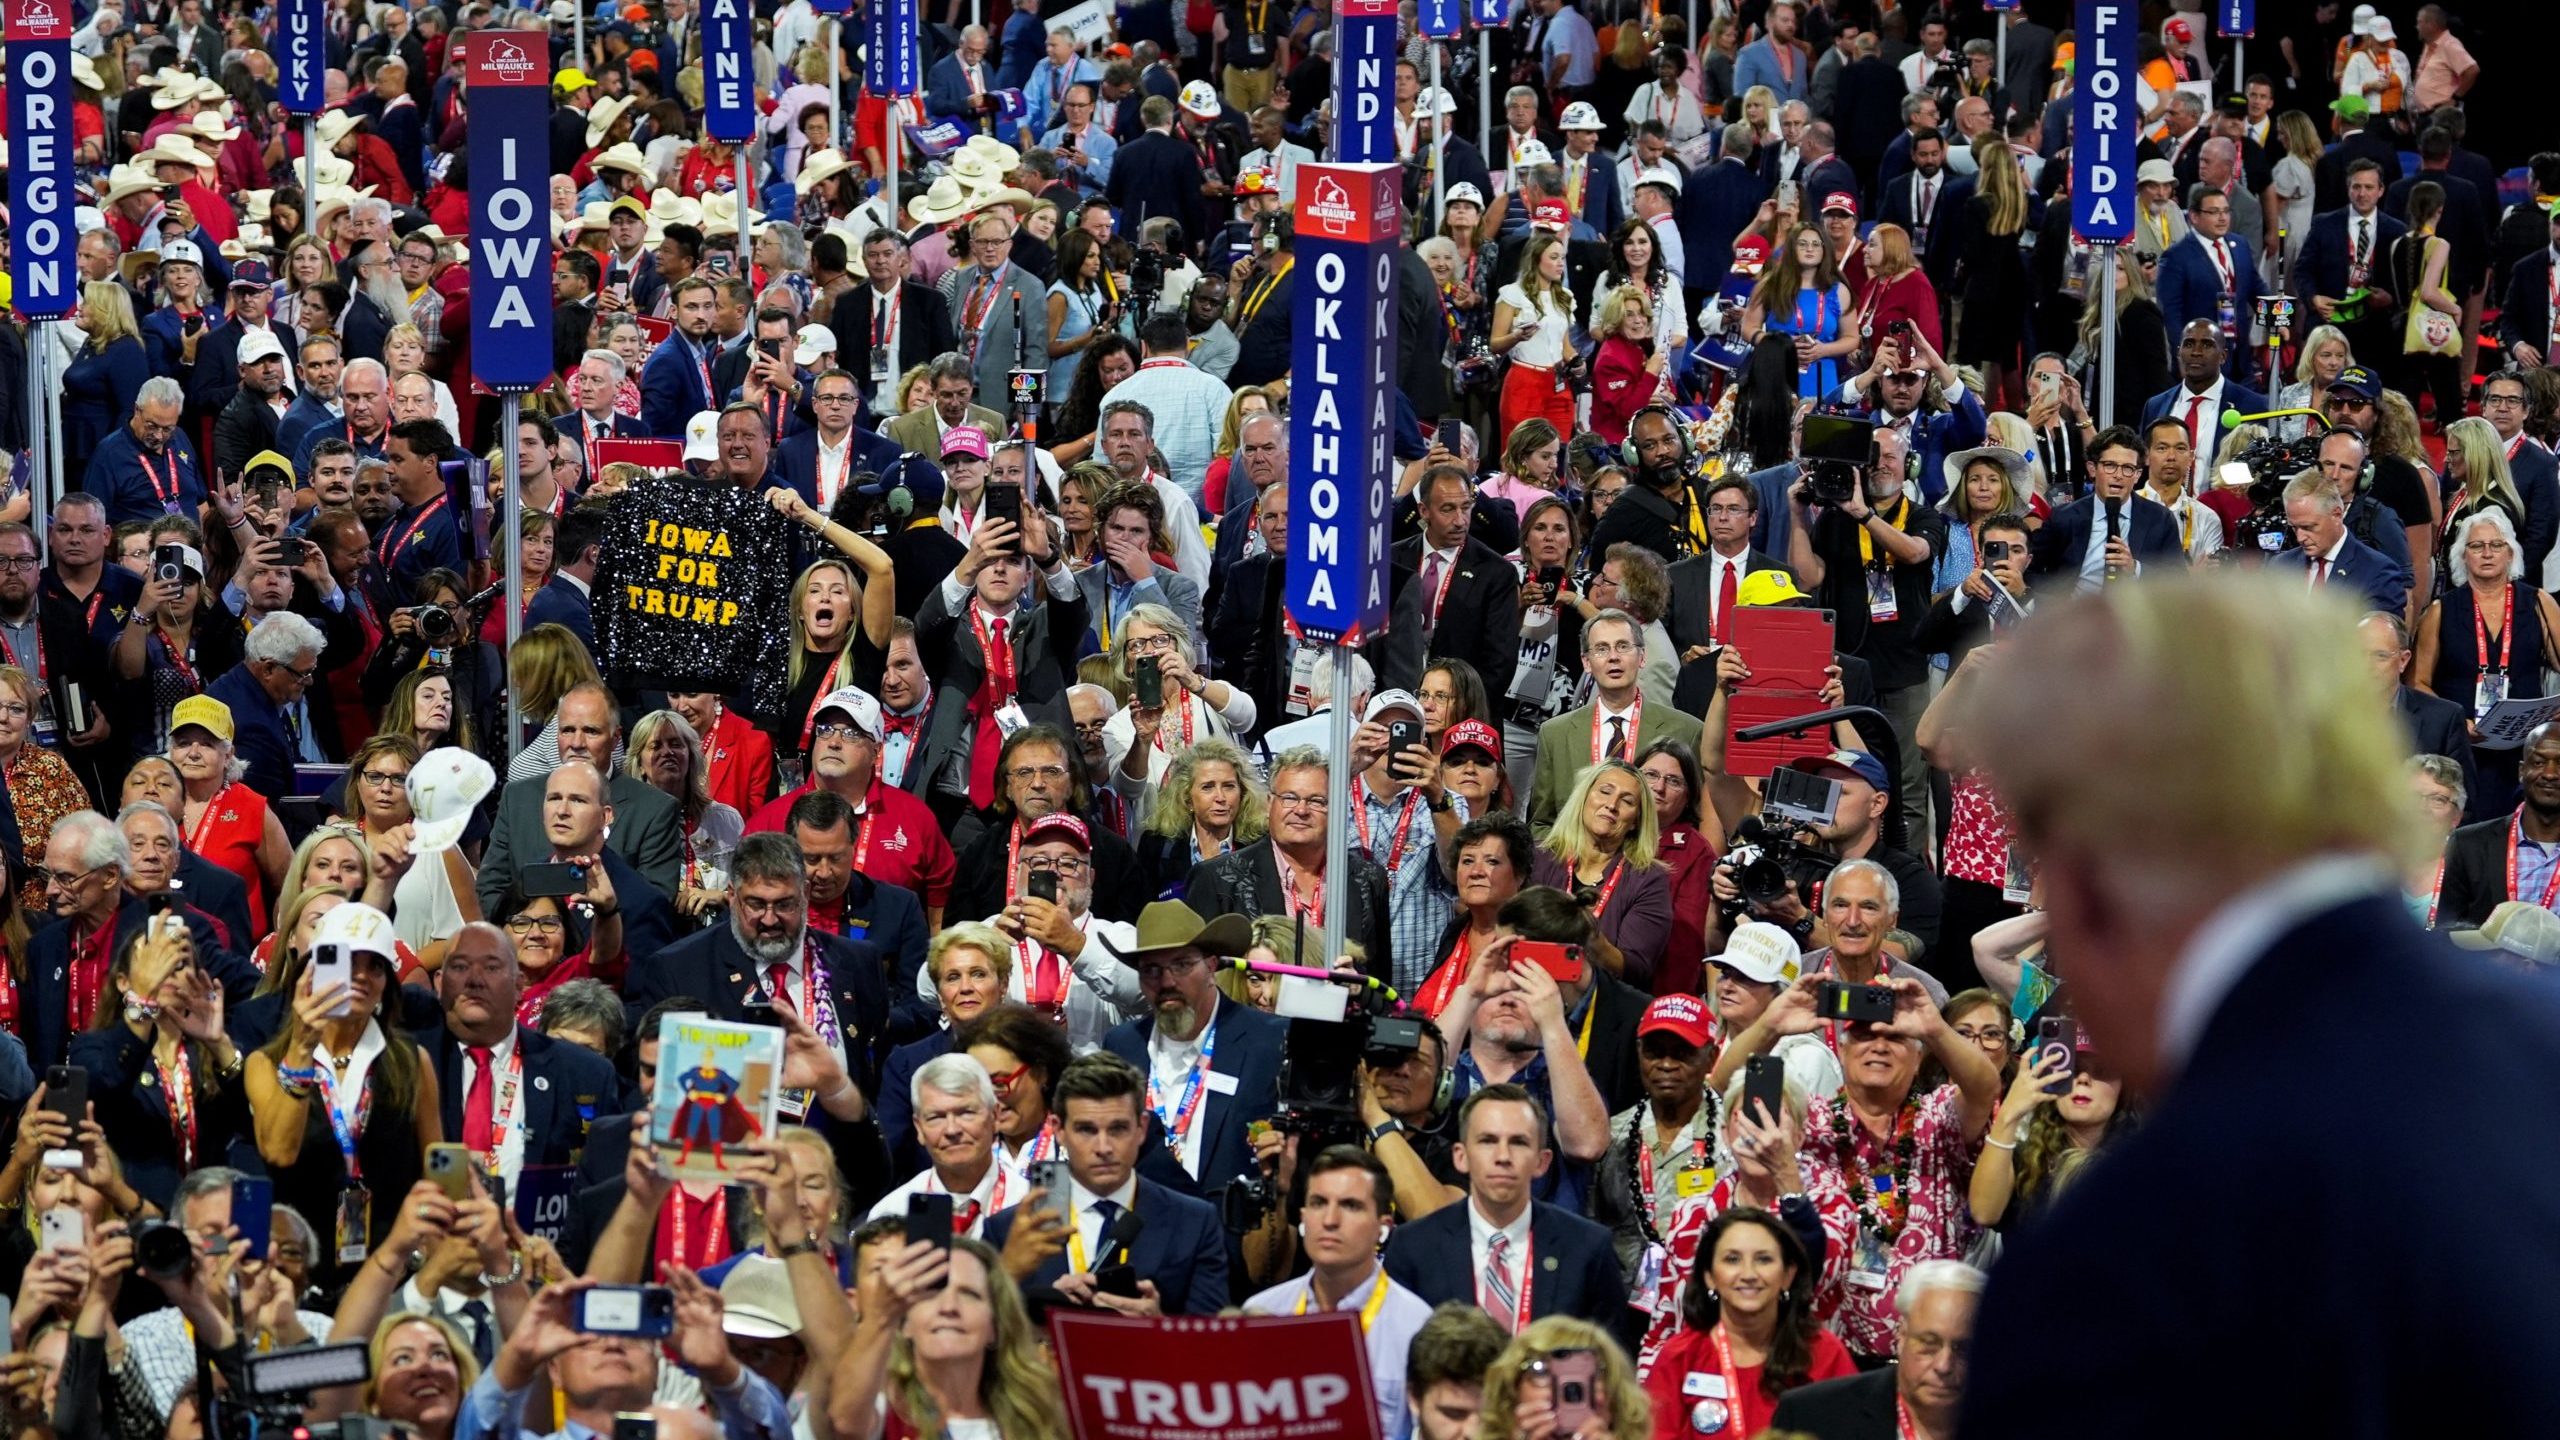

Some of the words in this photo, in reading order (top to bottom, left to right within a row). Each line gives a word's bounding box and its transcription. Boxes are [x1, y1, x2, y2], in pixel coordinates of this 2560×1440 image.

[16, 18, 59, 26] MILWAUKEE
[1071, 12, 1099, 30] UMP
[481, 63, 534, 71] MILWAUKEE
[874, 22, 884, 86] SAMOA
[900, 22, 909, 86] SAMOA
[1332, 23, 1340, 162] INDI
[1357, 25, 1380, 162] INDI
[2089, 6, 2120, 226] FLORIDA
[22, 50, 60, 298] OREGON
[1307, 205, 1356, 221] MILWAUKEE
[480, 138, 541, 328] IOWA
[1306, 252, 1346, 610] OKLAHOMA
[1367, 253, 1390, 610] OKLAHOMA
[645, 519, 732, 557] IOWA
[657, 554, 718, 588] FOR
[626, 585, 738, 626] TRUMP
[1520, 637, 1551, 662] MP
[1459, 722, 1484, 733] SAVE
[344, 913, 382, 940] 47
[1653, 1009, 1697, 1022] TRUMP
[1654, 996, 1701, 1012] HAWAII
[677, 1024, 751, 1047] TRUMP
[1083, 1374, 1350, 1428] TRUMP
